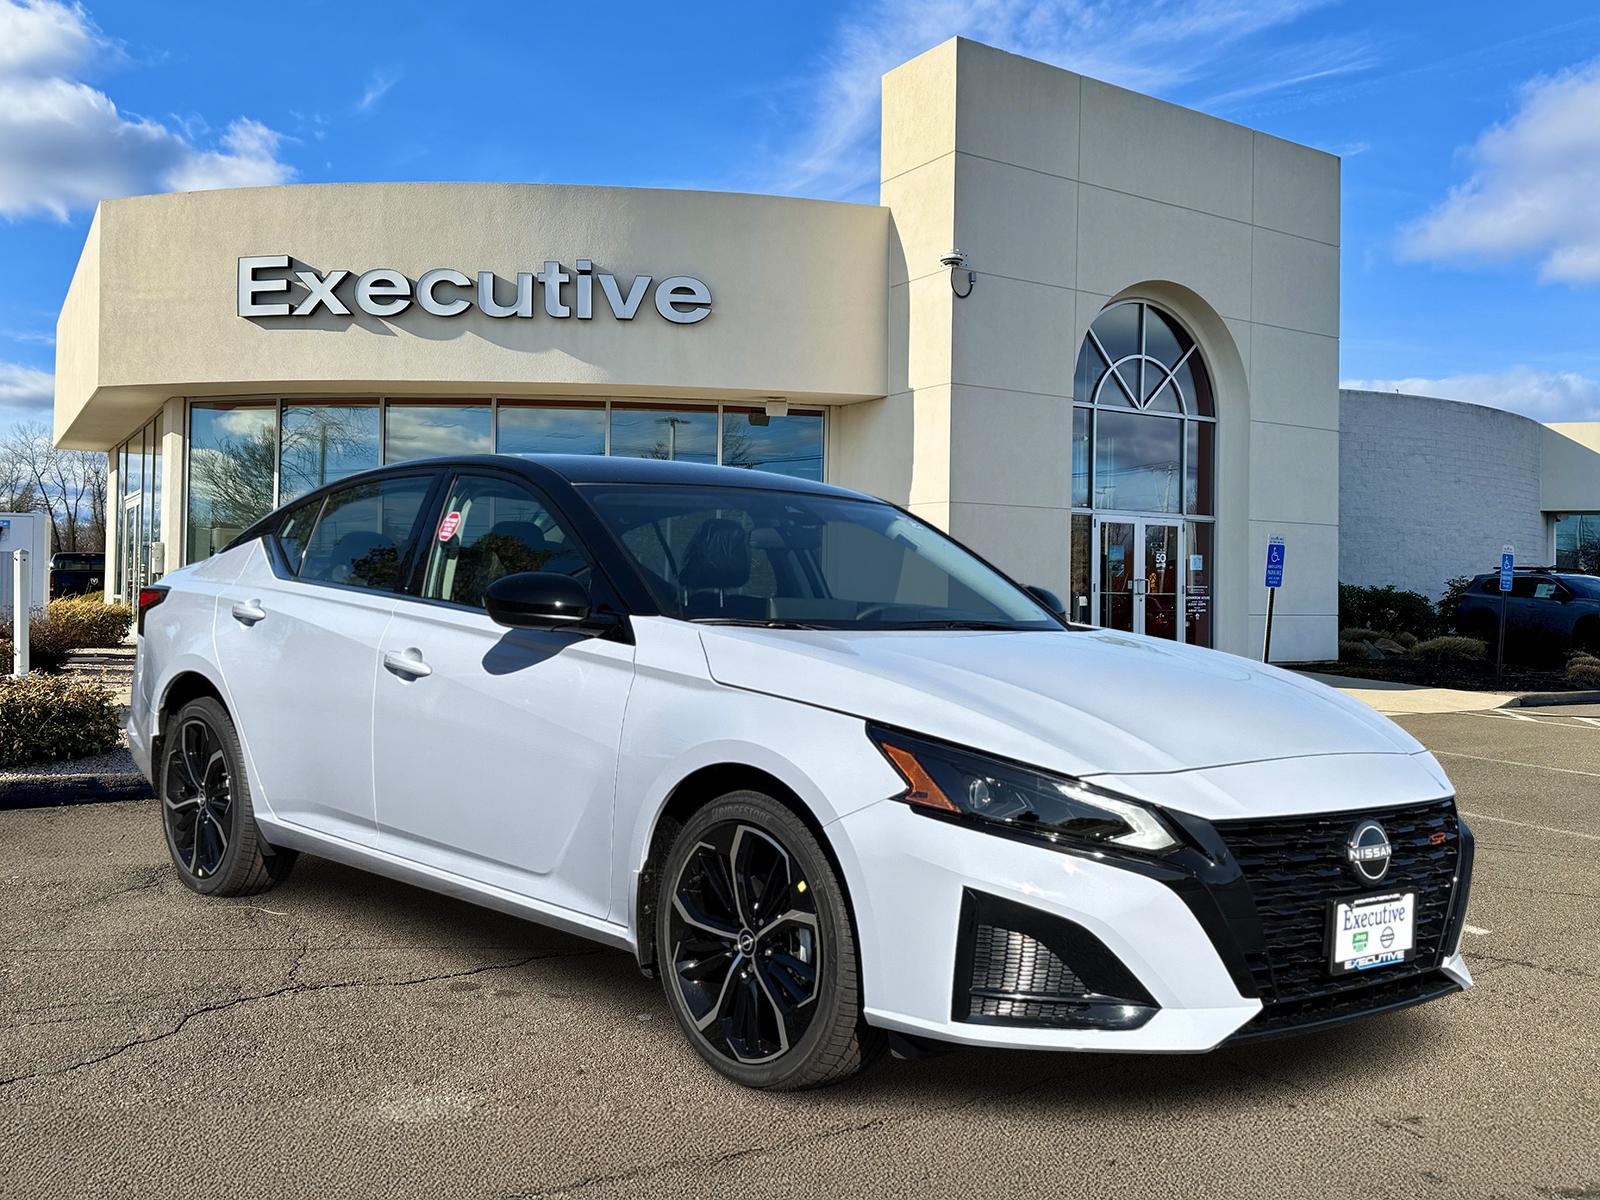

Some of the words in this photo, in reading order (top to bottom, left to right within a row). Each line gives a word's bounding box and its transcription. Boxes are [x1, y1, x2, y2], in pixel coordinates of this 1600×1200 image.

[237, 254, 712, 324] Executive
[1155, 553, 1167, 563] 50
[1349, 845, 1392, 860] NISSAN
[1343, 903, 1406, 931] Executive
[1344, 950, 1405, 970] EXECUTIVE
